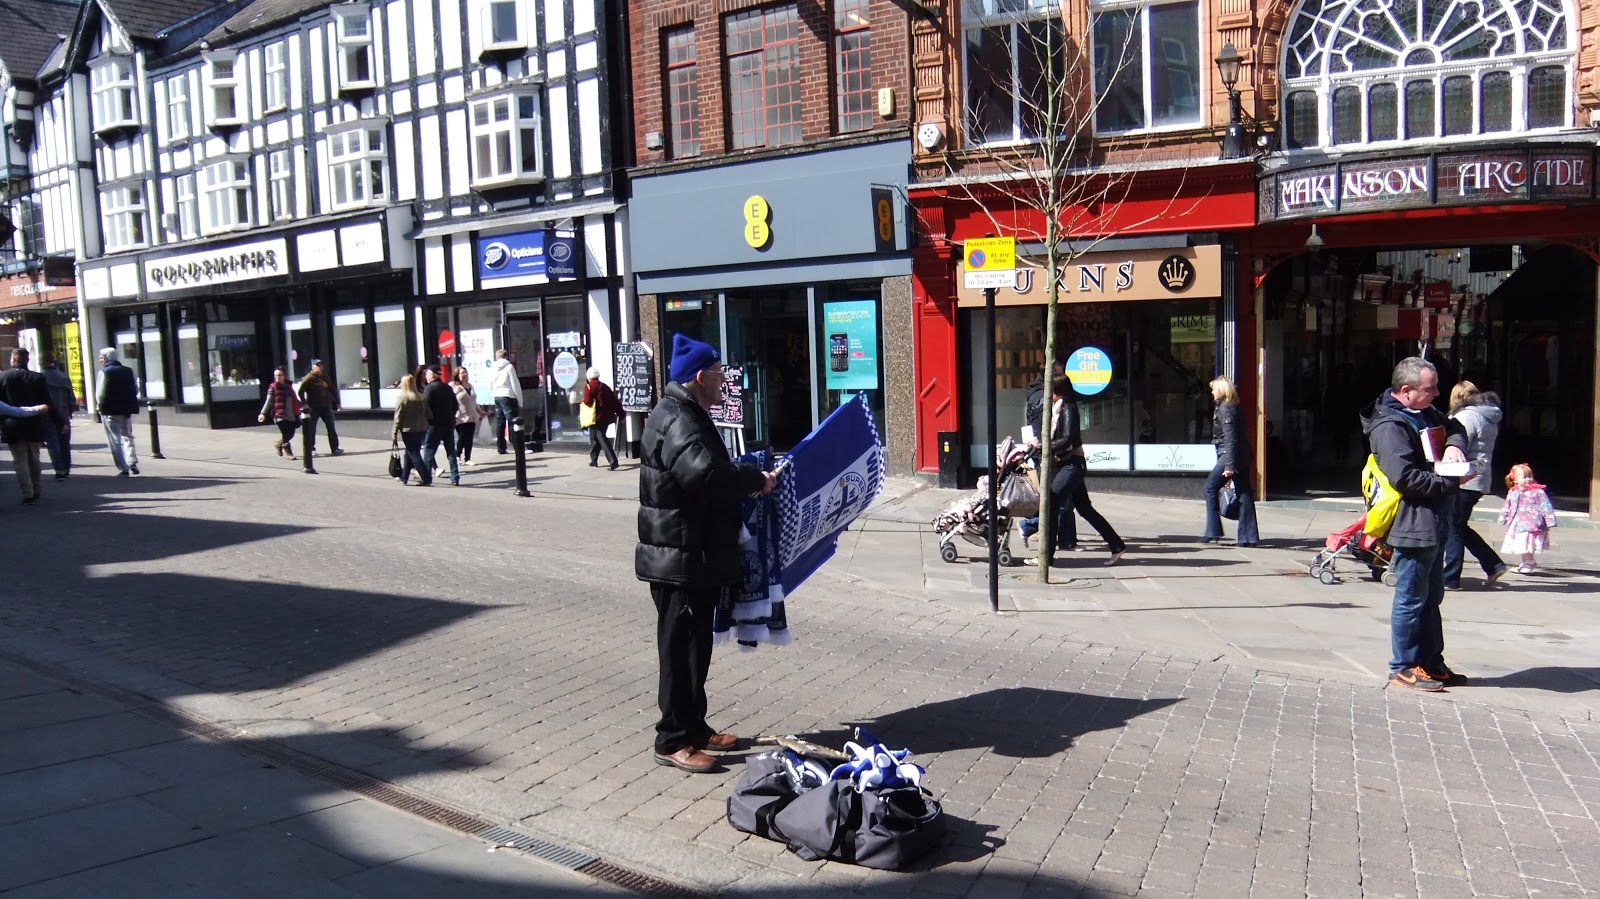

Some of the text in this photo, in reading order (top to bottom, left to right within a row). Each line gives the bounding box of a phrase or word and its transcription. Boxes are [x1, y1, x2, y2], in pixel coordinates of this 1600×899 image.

[1281, 160, 1584, 212] MAKINSON ARCADE
[511, 247, 543, 259] Opticians
[151, 250, 278, 285] GOLDSMITHS
[548, 266, 575, 274] Opticians
[980, 260, 1133, 295] URNS
[616, 344, 628, 353] GET
[1077, 350, 1100, 360] Free
[616, 355, 634, 367] 300
[1079, 361, 1099, 370] Gift
[617, 366, 633, 377] 500
[617, 376, 636, 387] 5000
[622, 387, 636, 405] £8
